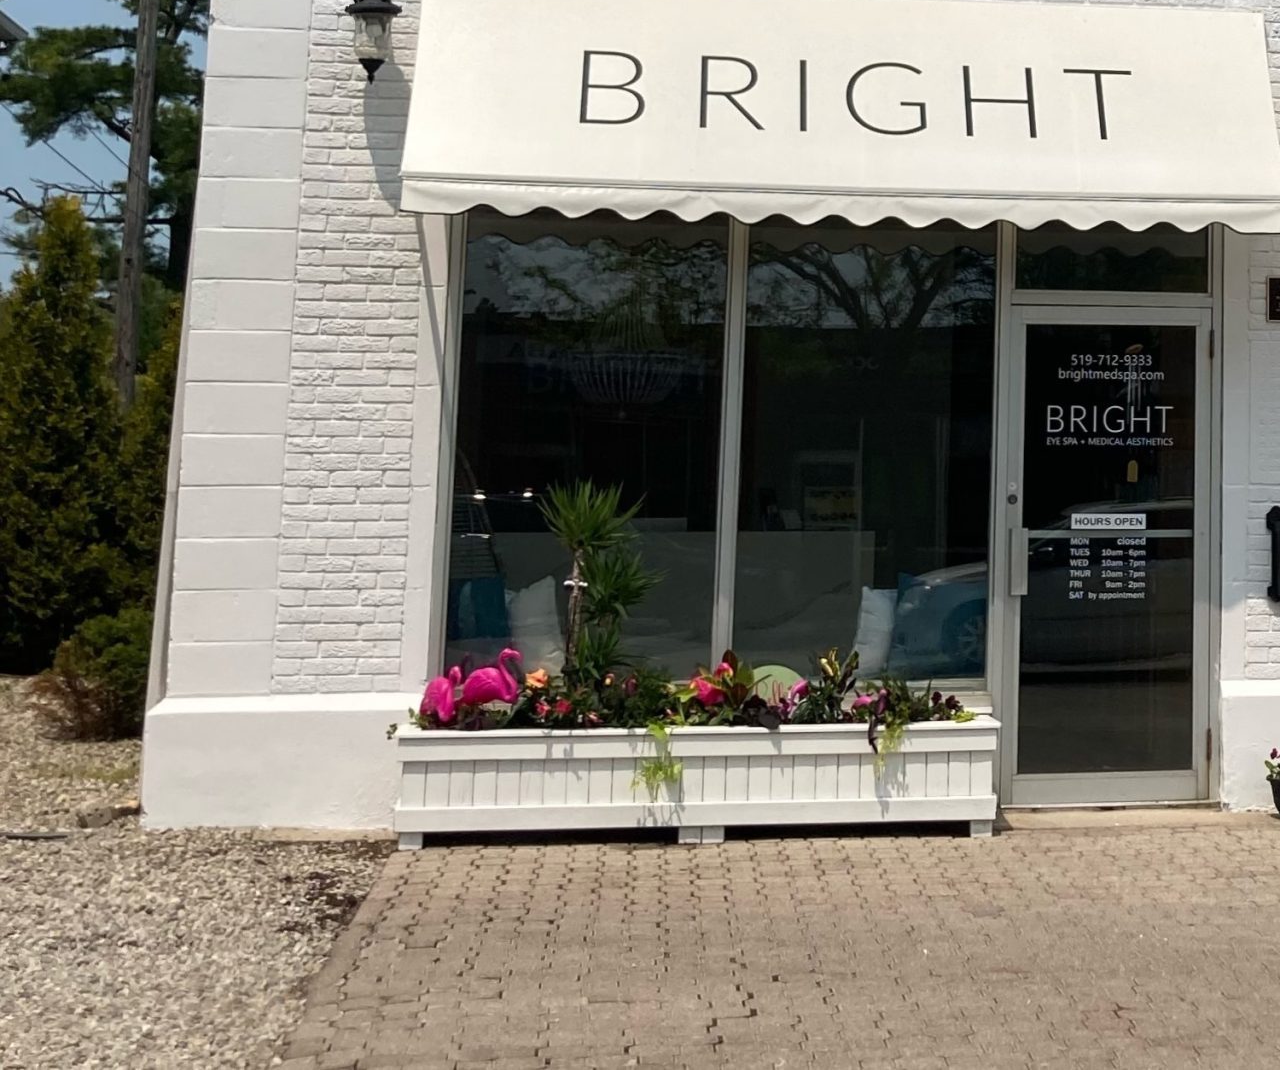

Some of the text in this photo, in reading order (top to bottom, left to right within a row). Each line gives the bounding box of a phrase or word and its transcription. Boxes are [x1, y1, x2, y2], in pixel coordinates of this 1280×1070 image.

[579, 49, 1132, 140] BRIGHT
[1071, 354, 1153, 366] 519-712-9333
[1058, 367, 1165, 382] brightmedspa.com
[1046, 405, 1174, 433] BRIGHT
[1046, 437, 1061, 446] EYE
[1063, 437, 1078, 446] SPA
[1088, 437, 1125, 446] MEDICAL
[1126, 437, 1174, 446] AESTHETICS
[1074, 517, 1143, 526] HOURS OPEN
[1070, 536, 1146, 546] MON closed
[1070, 548, 1090, 556] TUES
[1069, 559, 1089, 567] WED
[1069, 570, 1091, 578] THUR
[1069, 580, 1083, 589] FRI
[1069, 591, 1146, 600] SAT by appointment
